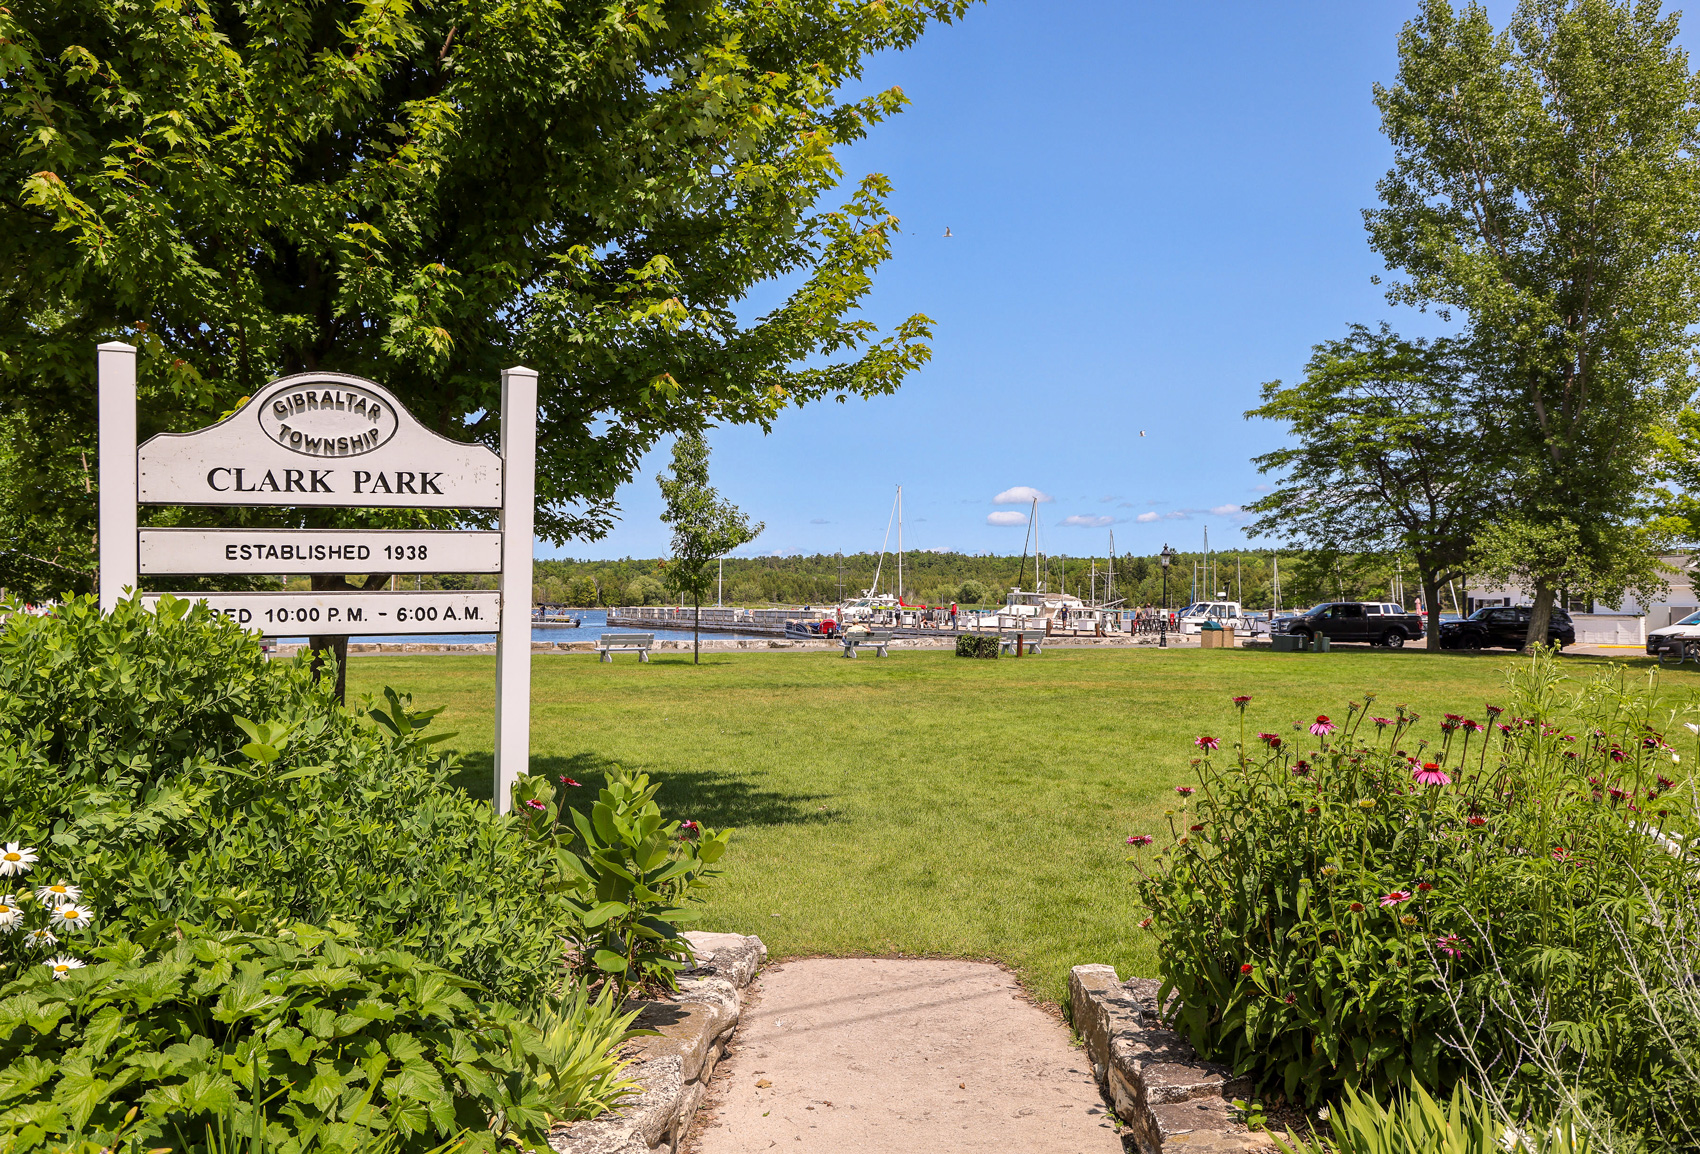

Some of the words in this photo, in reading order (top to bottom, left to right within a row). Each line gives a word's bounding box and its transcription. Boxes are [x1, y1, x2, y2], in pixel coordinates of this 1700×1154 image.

[272, 390, 381, 418] GIBRALTAR
[279, 423, 379, 450] TOWNSHIP
[207, 467, 334, 493] CLARK
[353, 470, 444, 495] PARK
[225, 544, 370, 561] ESTABLISHED
[384, 545, 428, 561] 1938
[265, 608, 320, 622] 10:00
[328, 607, 368, 622] P.M.
[396, 606, 438, 621] 6:00
[443, 606, 484, 621] A.M.
